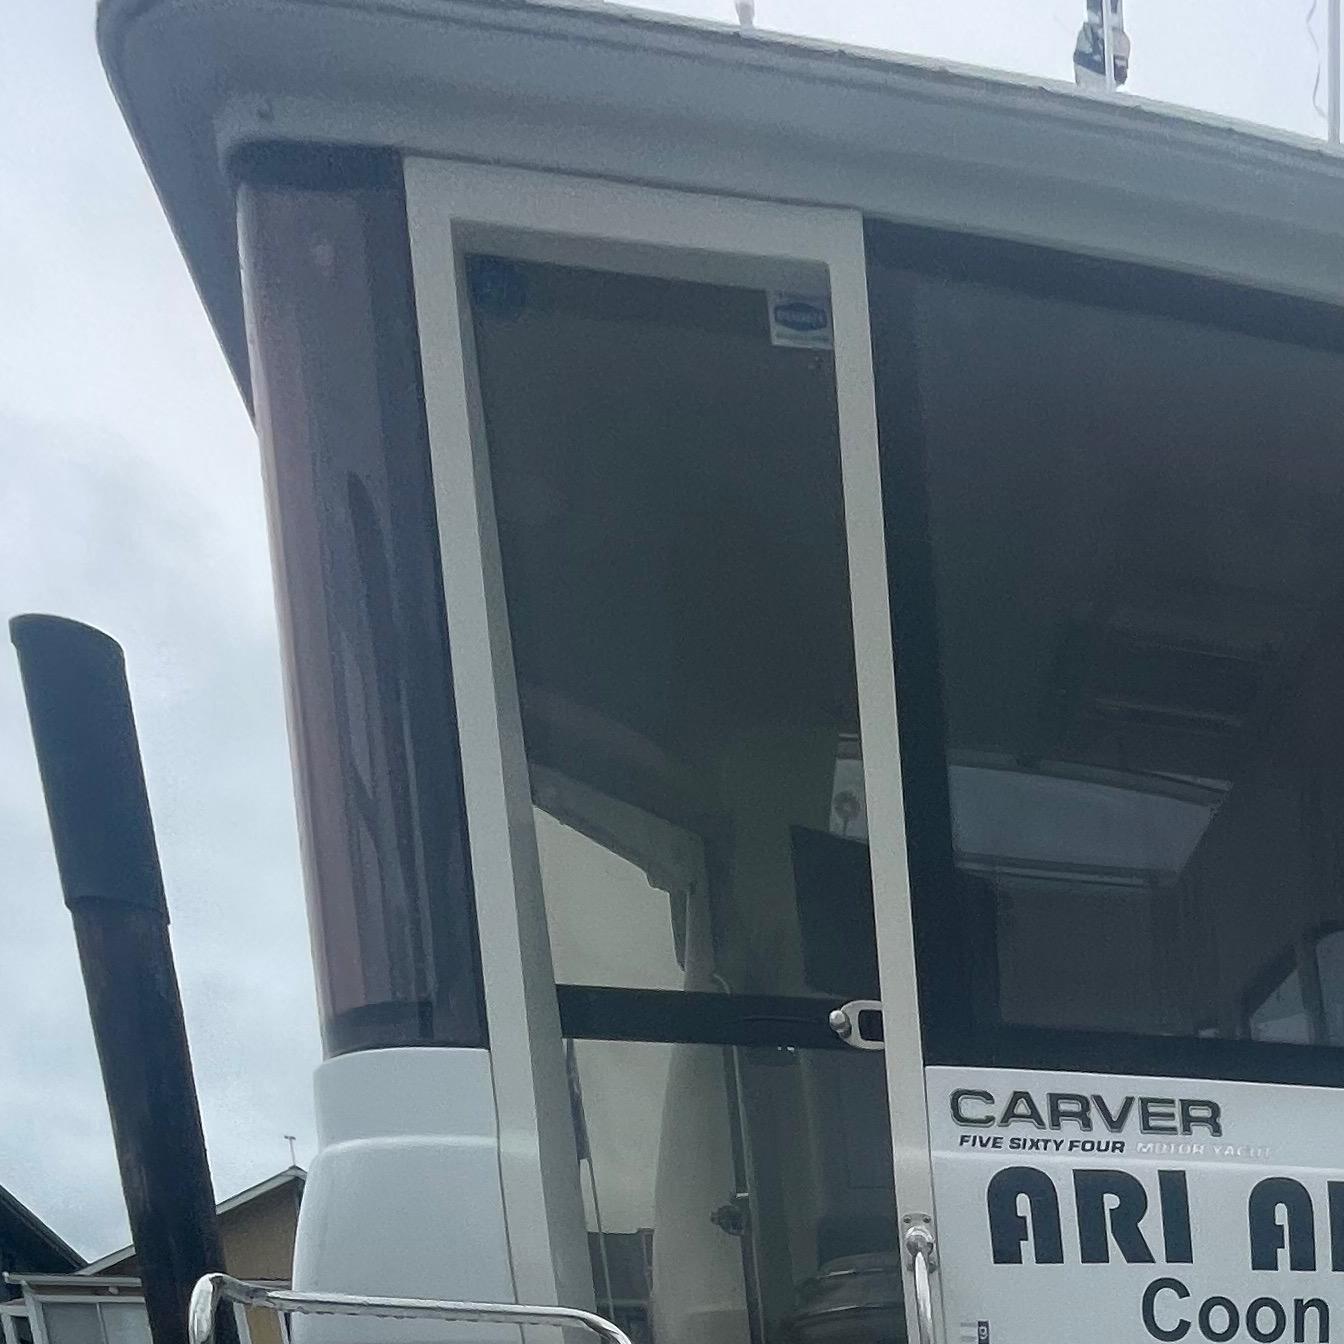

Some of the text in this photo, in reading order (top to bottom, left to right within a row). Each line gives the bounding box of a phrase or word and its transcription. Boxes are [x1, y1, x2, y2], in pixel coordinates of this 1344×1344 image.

[949, 1087, 1224, 1138] CARVER
[959, 1134, 1003, 1149] FIVE
[1008, 1137, 1064, 1152] SIXTY
[1068, 1139, 1126, 1154] FOUR
[1136, 1142, 1205, 1156] MOTOR
[987, 1166, 1194, 1265] ARI
[1141, 1277, 1330, 1344] Coon
